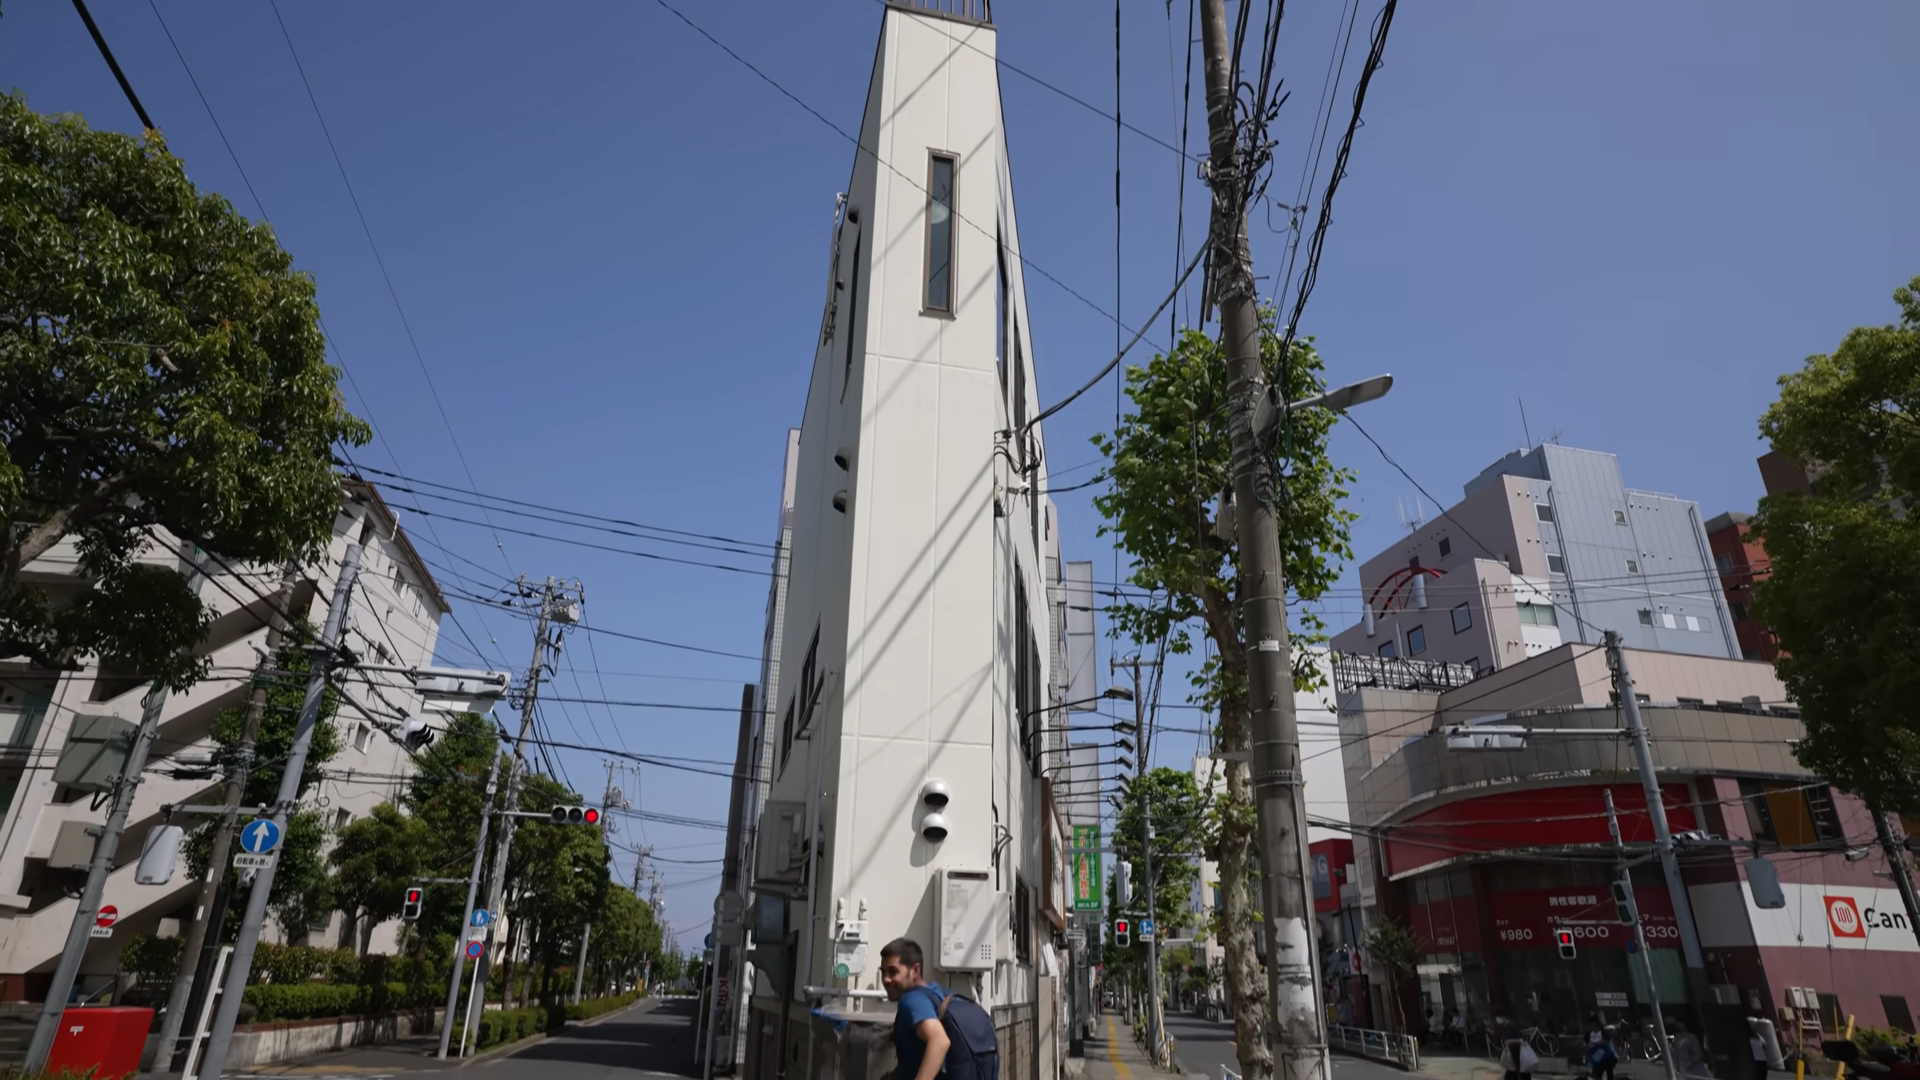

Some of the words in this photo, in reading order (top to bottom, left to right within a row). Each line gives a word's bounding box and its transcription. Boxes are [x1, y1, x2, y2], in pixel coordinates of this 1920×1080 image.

[412, 589, 423, 618] 13
[1835, 906, 1853, 924] 100
[1500, 928, 1533, 941] ¥980
